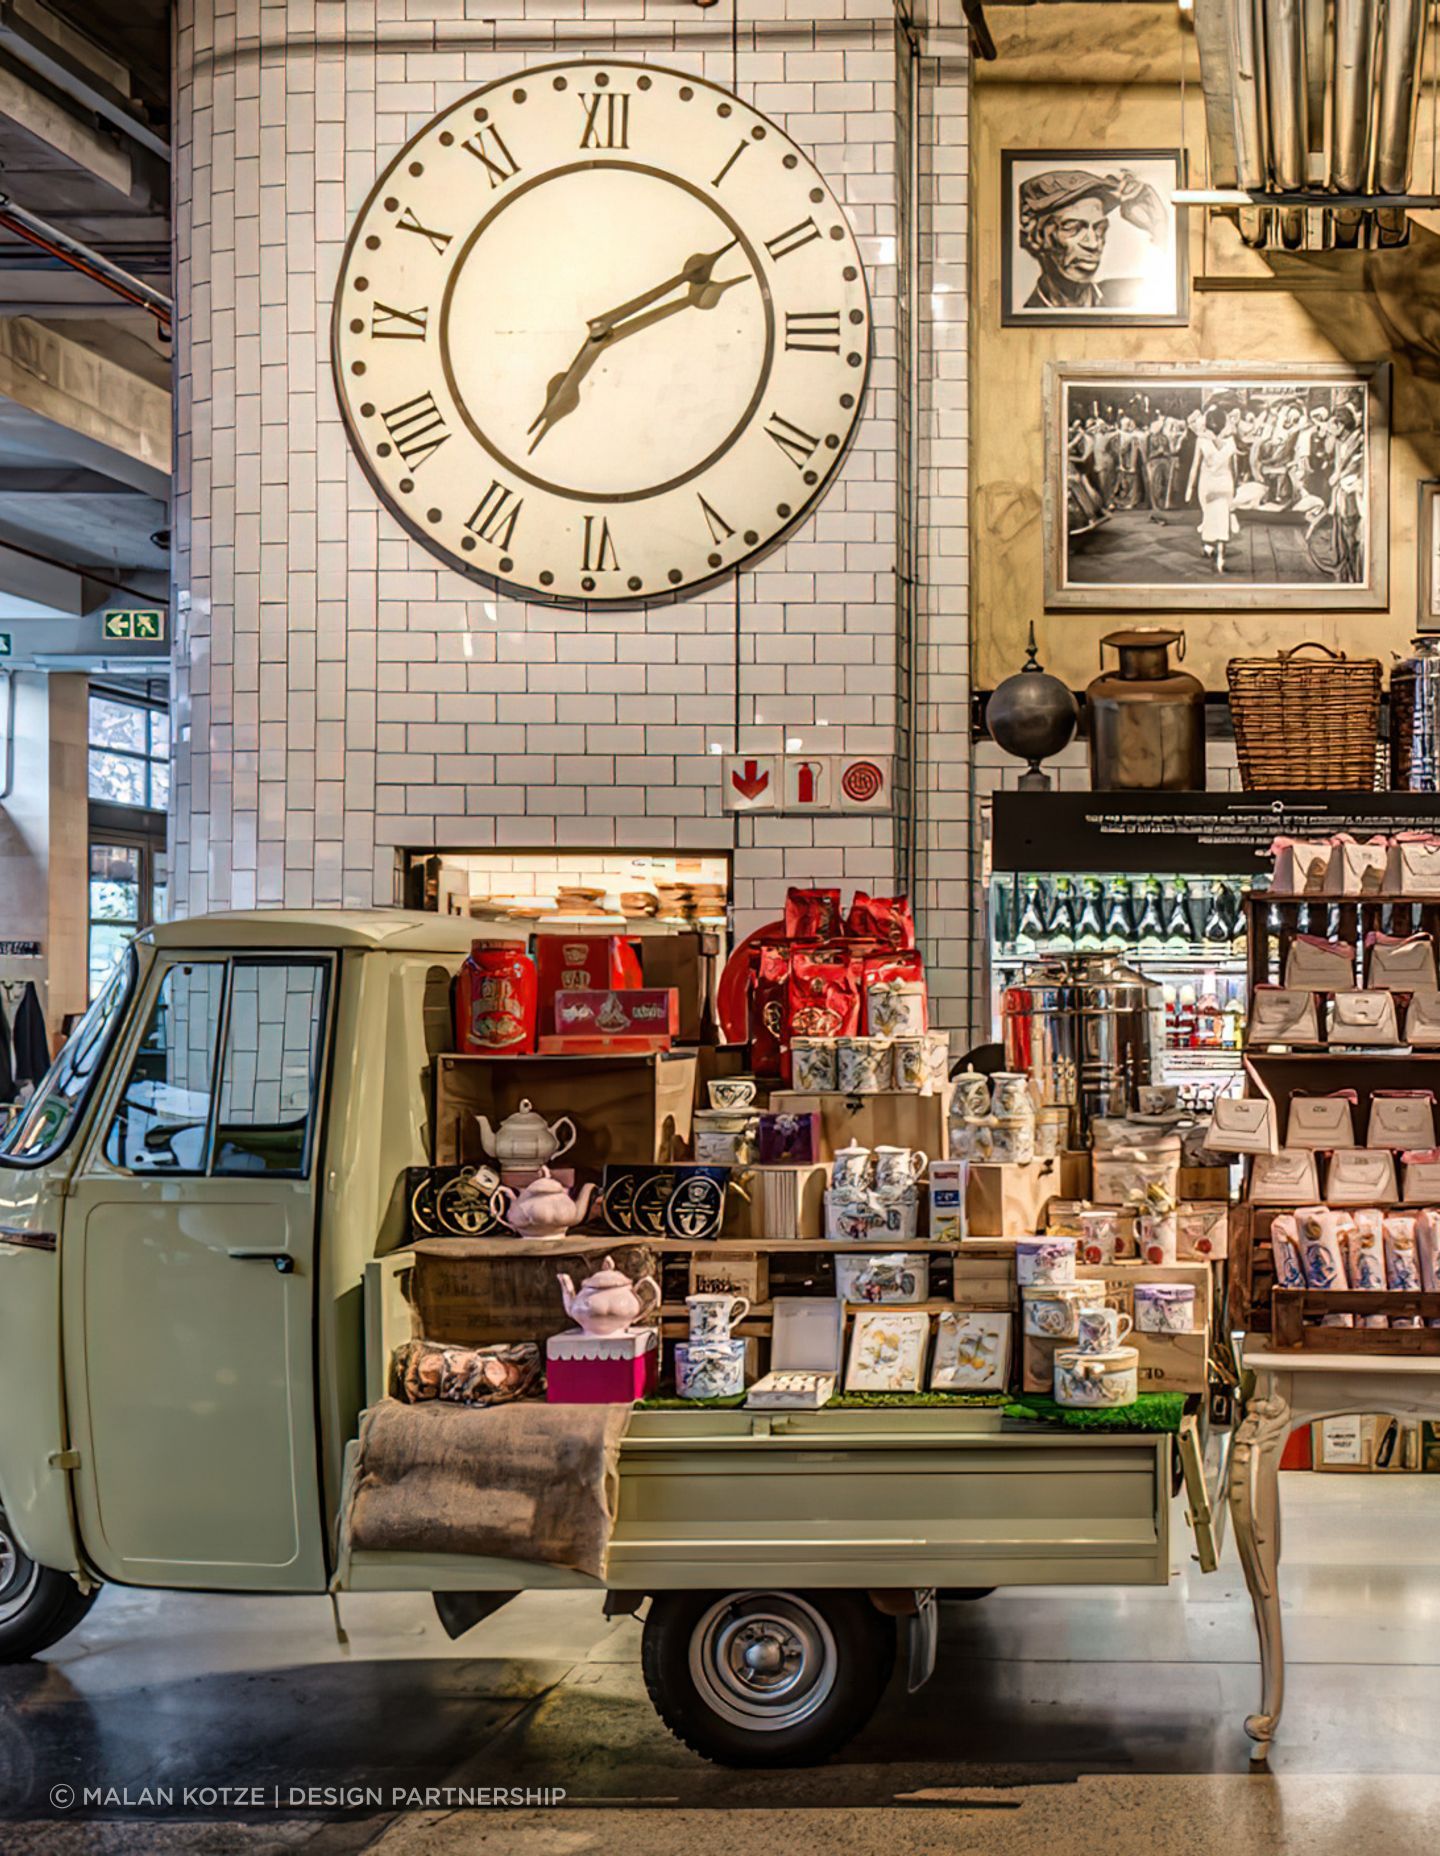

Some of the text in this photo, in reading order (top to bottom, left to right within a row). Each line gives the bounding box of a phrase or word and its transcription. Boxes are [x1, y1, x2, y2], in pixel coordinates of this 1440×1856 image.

[578, 92, 630, 150] XII
[461, 123, 522, 188] XI
[711, 139, 750, 188] I
[396, 207, 453, 254] X
[764, 216, 822, 262] II
[372, 301, 429, 342] IX
[785, 310, 841, 355] III
[382, 391, 452, 472] VIII
[764, 411, 820, 470] IV
[464, 480, 525, 551] VII
[697, 492, 736, 546] V
[581, 515, 621, 572] VI
